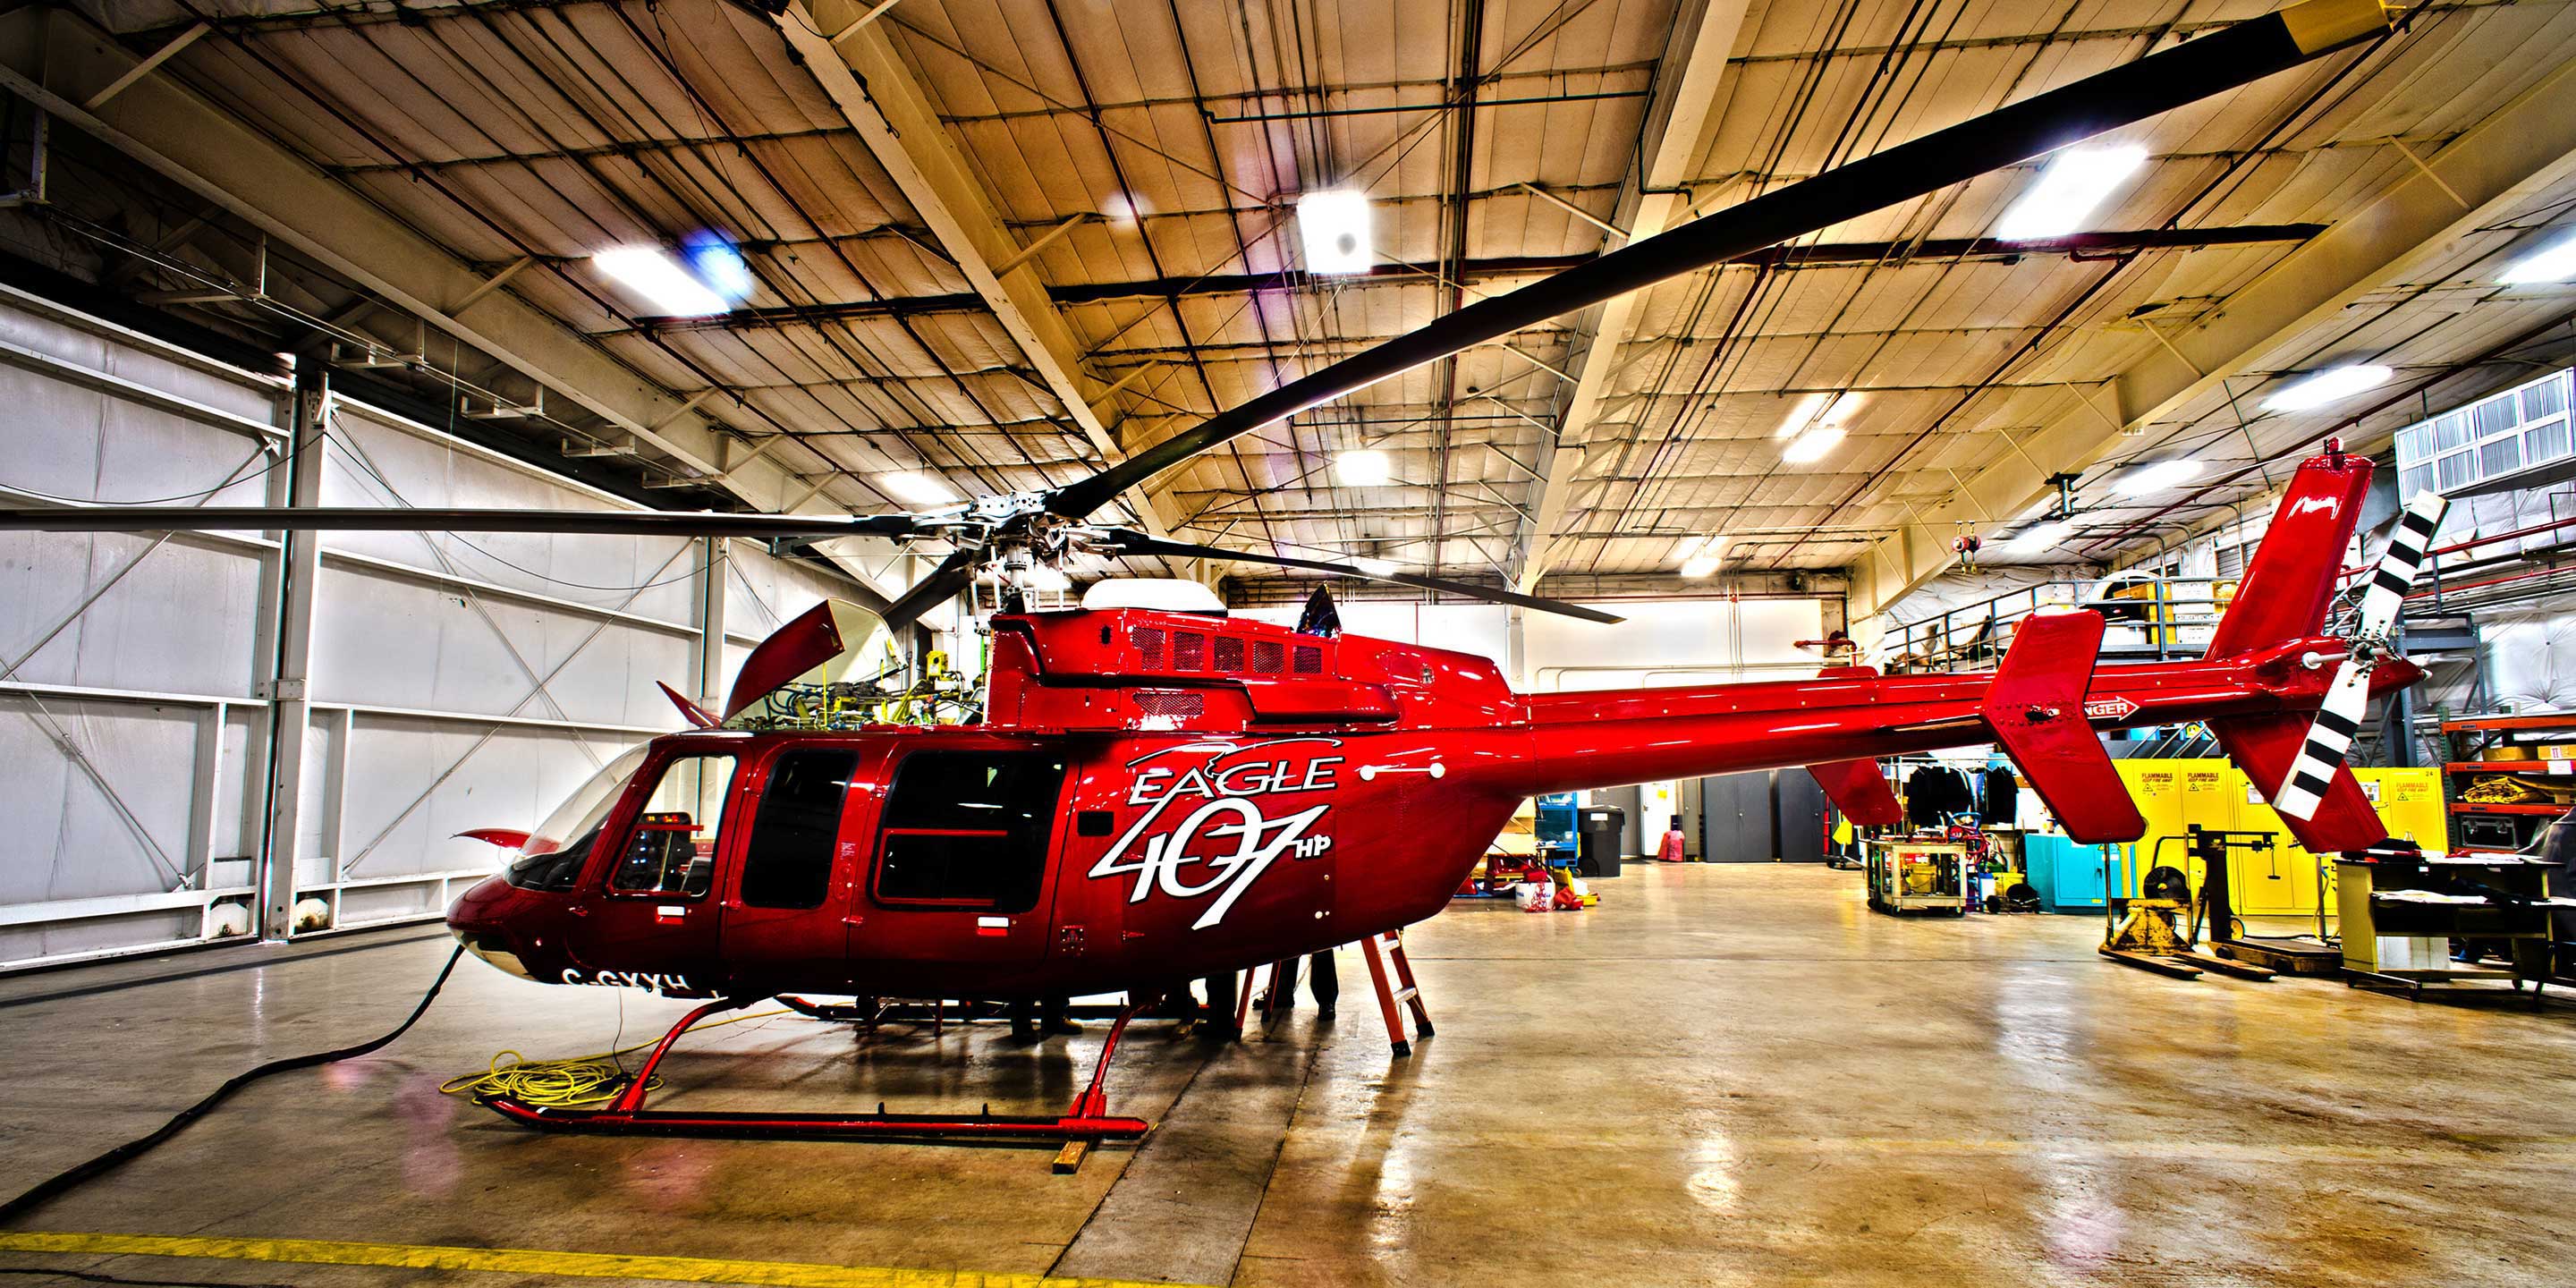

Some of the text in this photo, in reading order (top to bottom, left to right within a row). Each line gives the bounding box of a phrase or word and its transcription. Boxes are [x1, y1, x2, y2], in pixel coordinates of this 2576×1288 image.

[2084, 703, 2128, 716] NGER
[1127, 757, 1344, 806] EAGLE
[1088, 795, 1332, 931] 407 HP
